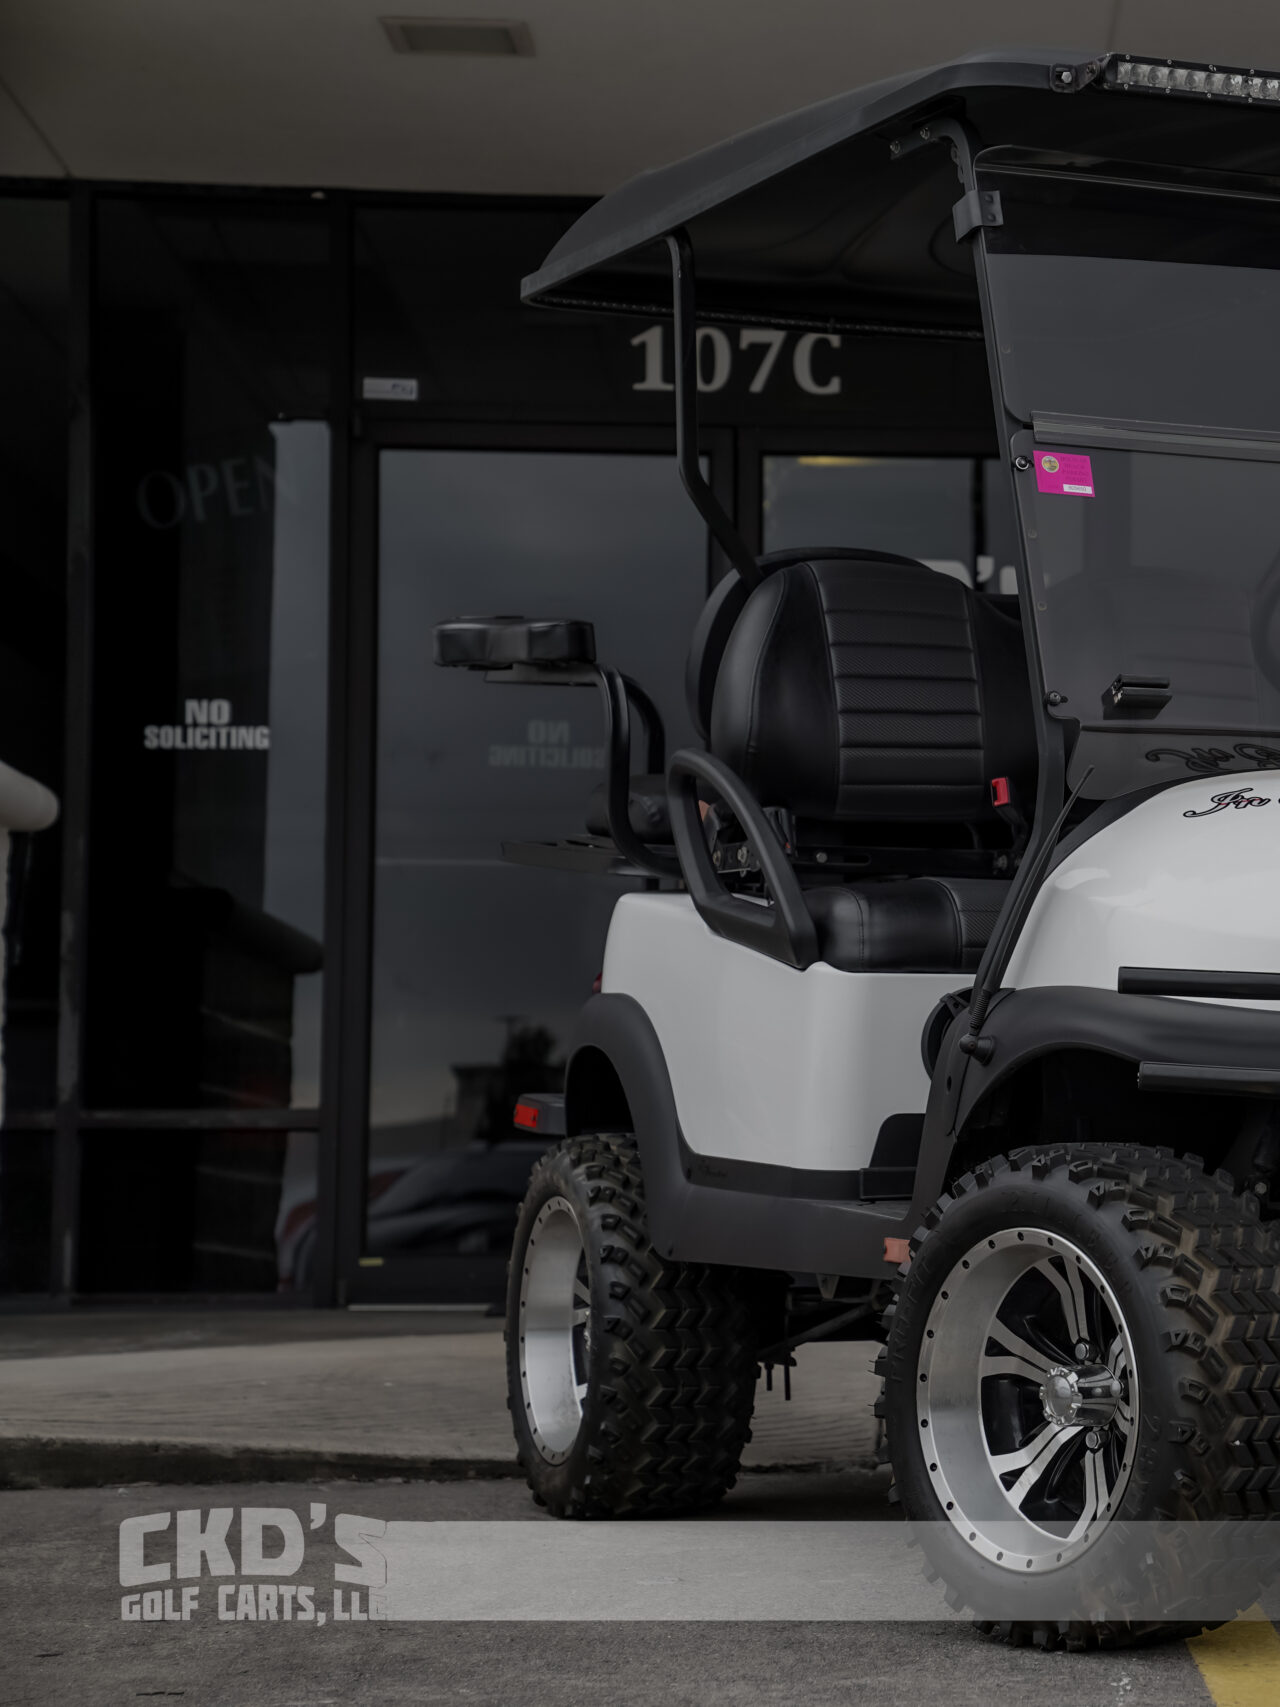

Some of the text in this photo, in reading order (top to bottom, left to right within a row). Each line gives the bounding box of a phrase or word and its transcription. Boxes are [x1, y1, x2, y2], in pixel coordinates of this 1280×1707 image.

[630, 324, 842, 396] 107C
[184, 698, 232, 725] NO
[143, 724, 271, 750] SOLICITING
[1183, 788, 1271, 818] In
